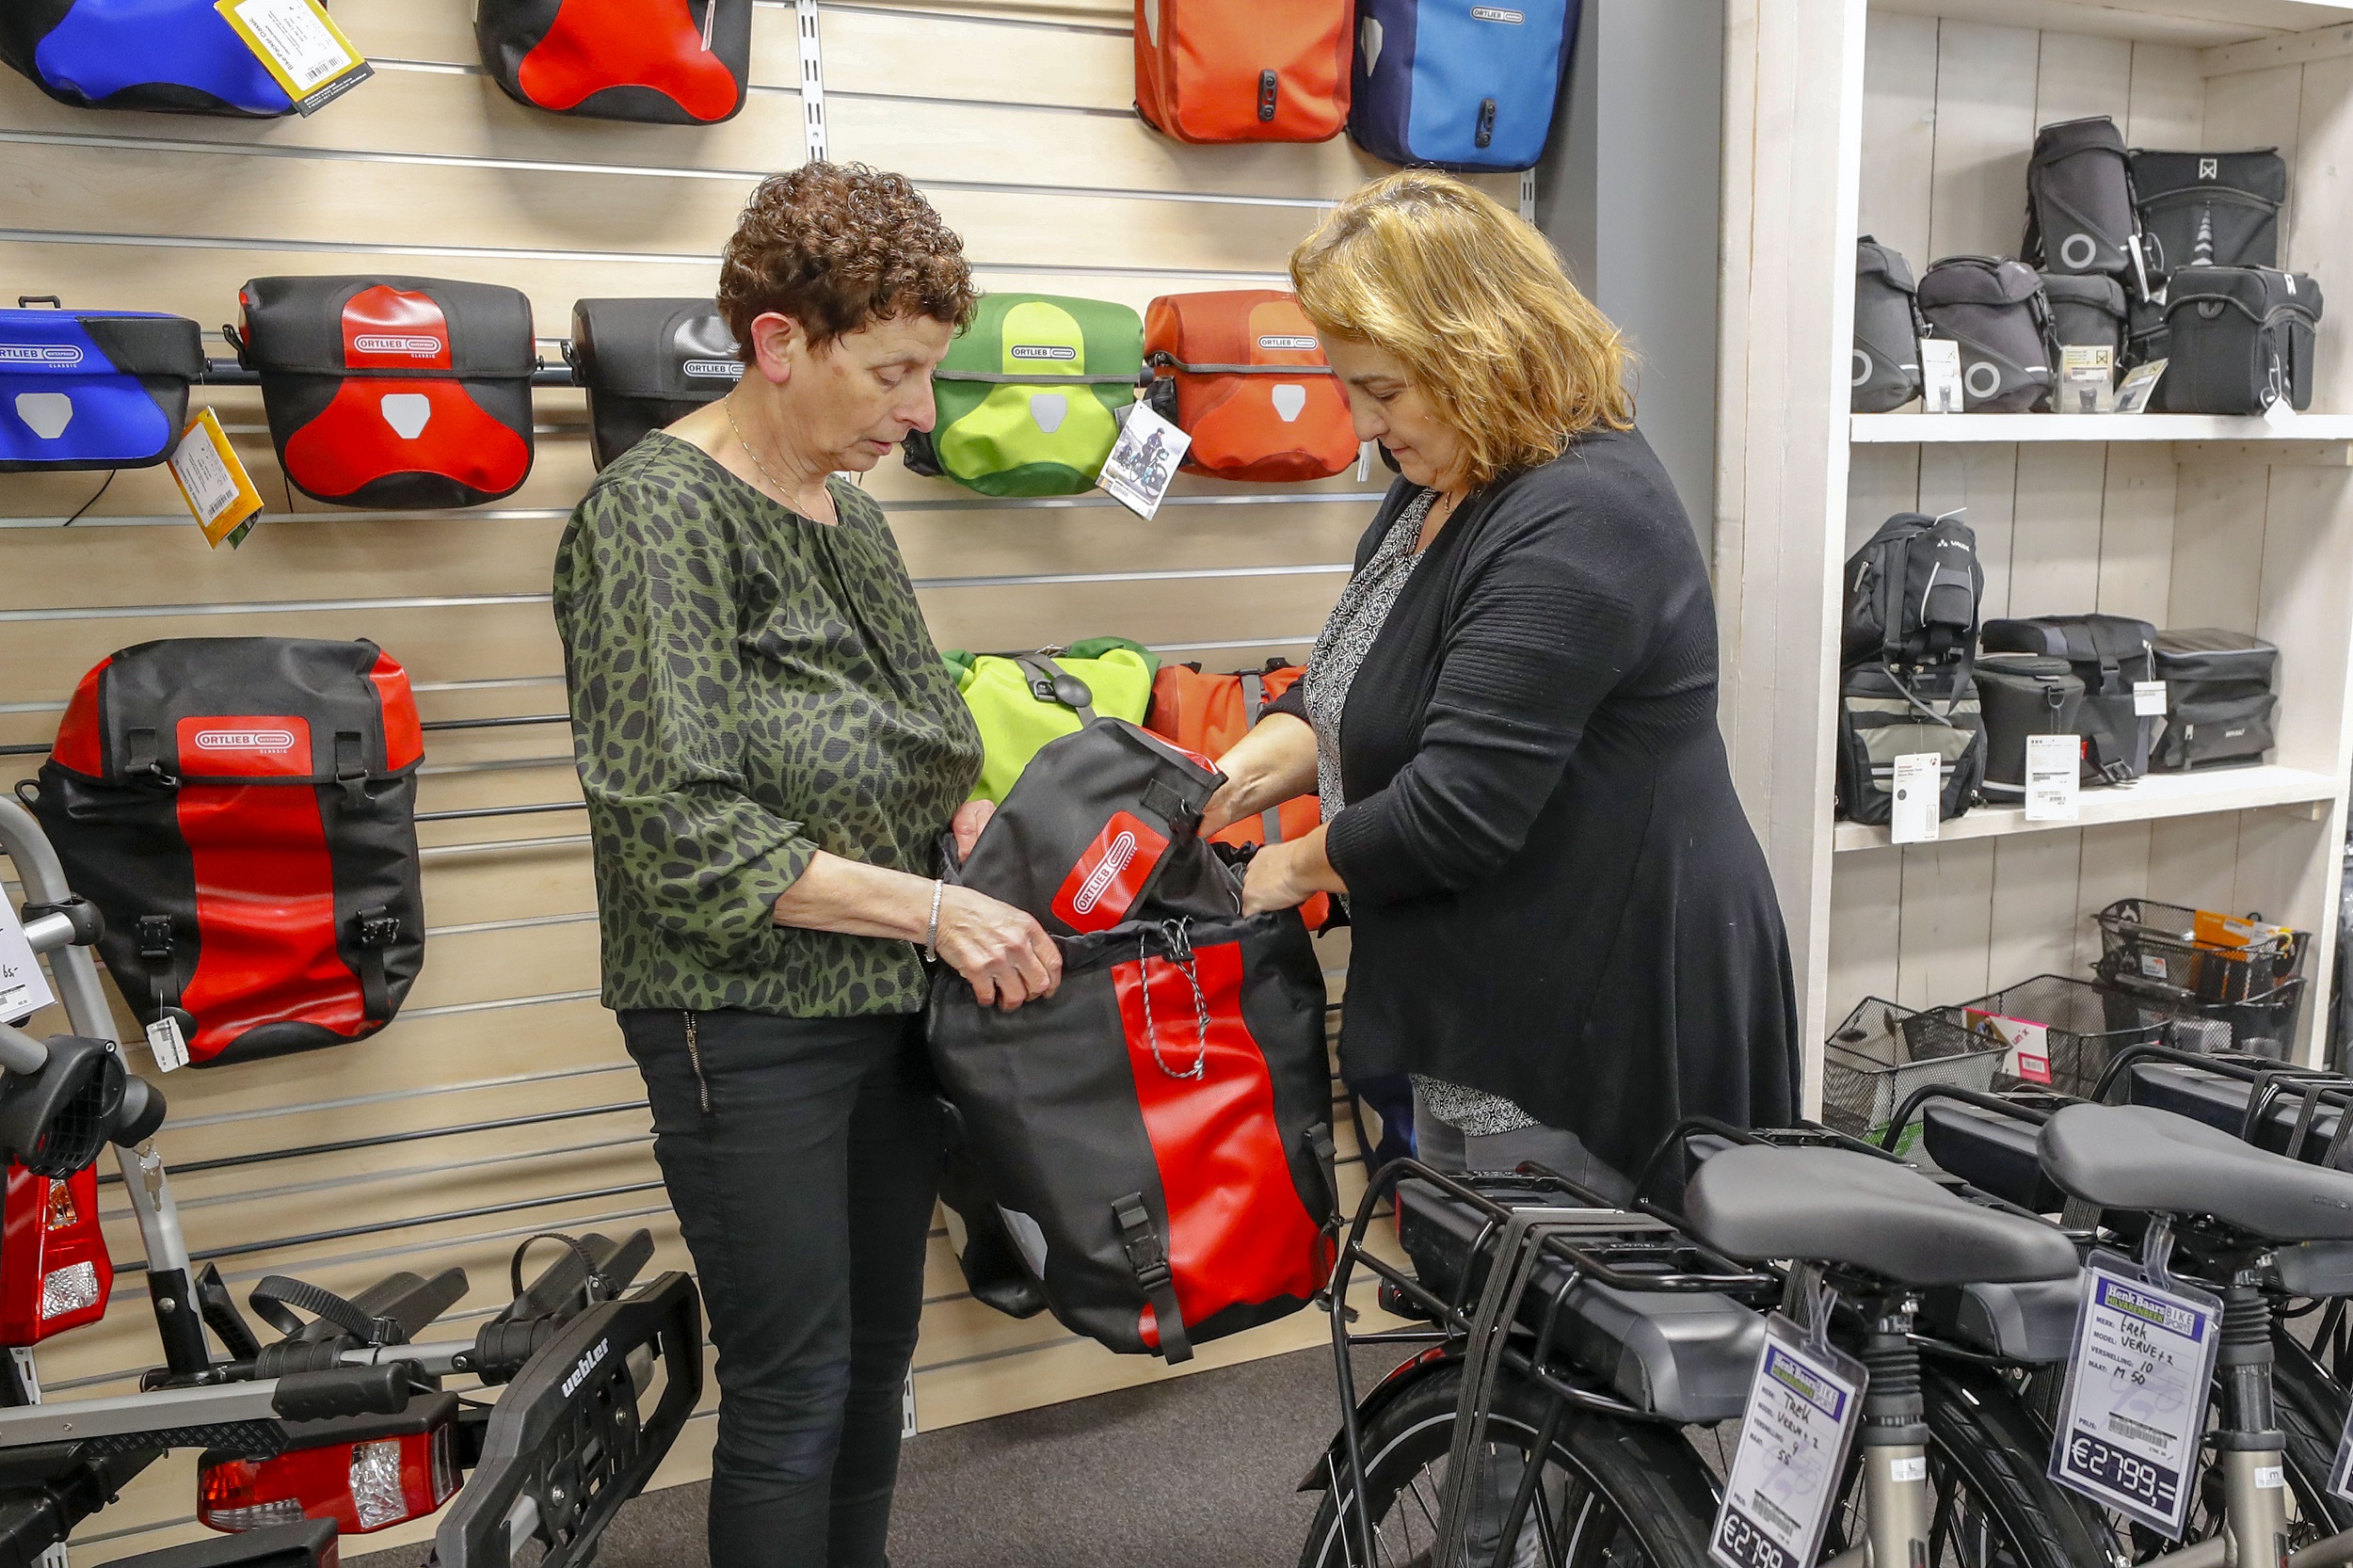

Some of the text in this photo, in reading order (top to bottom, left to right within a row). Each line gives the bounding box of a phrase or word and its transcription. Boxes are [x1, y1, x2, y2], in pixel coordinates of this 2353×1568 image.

[1474, 9, 1501, 18] ORTLIEB
[248, 17, 267, 38] Classic
[360, 340, 402, 348] ORTLIEB
[0, 349, 38, 358] RTLIEB
[202, 736, 250, 744] ORTLIEB
[1122, 846, 1138, 871] CLASSIC
[1079, 868, 1110, 908] ORTLIEB
[2108, 1286, 2193, 1325] Henk Baars BIKE
[2096, 1315, 2115, 1328] MERK:
[2106, 1296, 2191, 1335] HILVARENBEEK SPORTS
[2093, 1330, 2117, 1346] MODEL:
[2090, 1345, 2134, 1367] VERSNELLING:
[561, 1337, 608, 1398] uebler
[2088, 1360, 2108, 1373] MAAT:
[2140, 1361, 2153, 1373] 10
[2114, 1366, 2145, 1385] M 50
